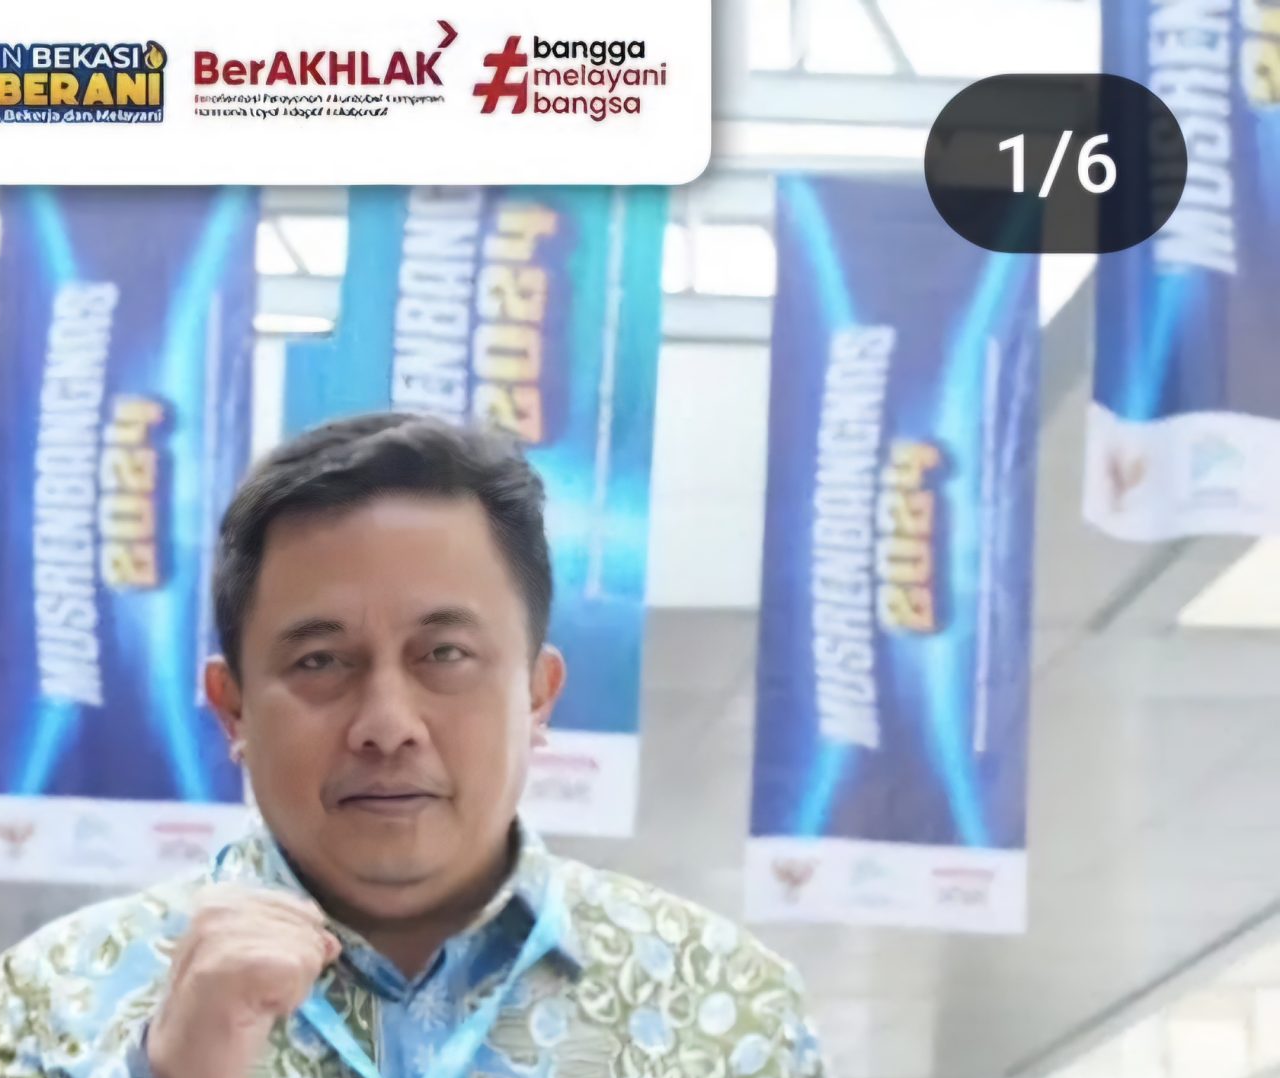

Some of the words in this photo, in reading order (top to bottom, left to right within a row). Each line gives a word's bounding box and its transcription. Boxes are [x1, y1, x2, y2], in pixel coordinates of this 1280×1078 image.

[472, 205, 559, 443] 2024
[33, 280, 120, 706] MUSRENBANGNAS
[101, 393, 164, 588] 2024
[875, 438, 940, 632] 2024
